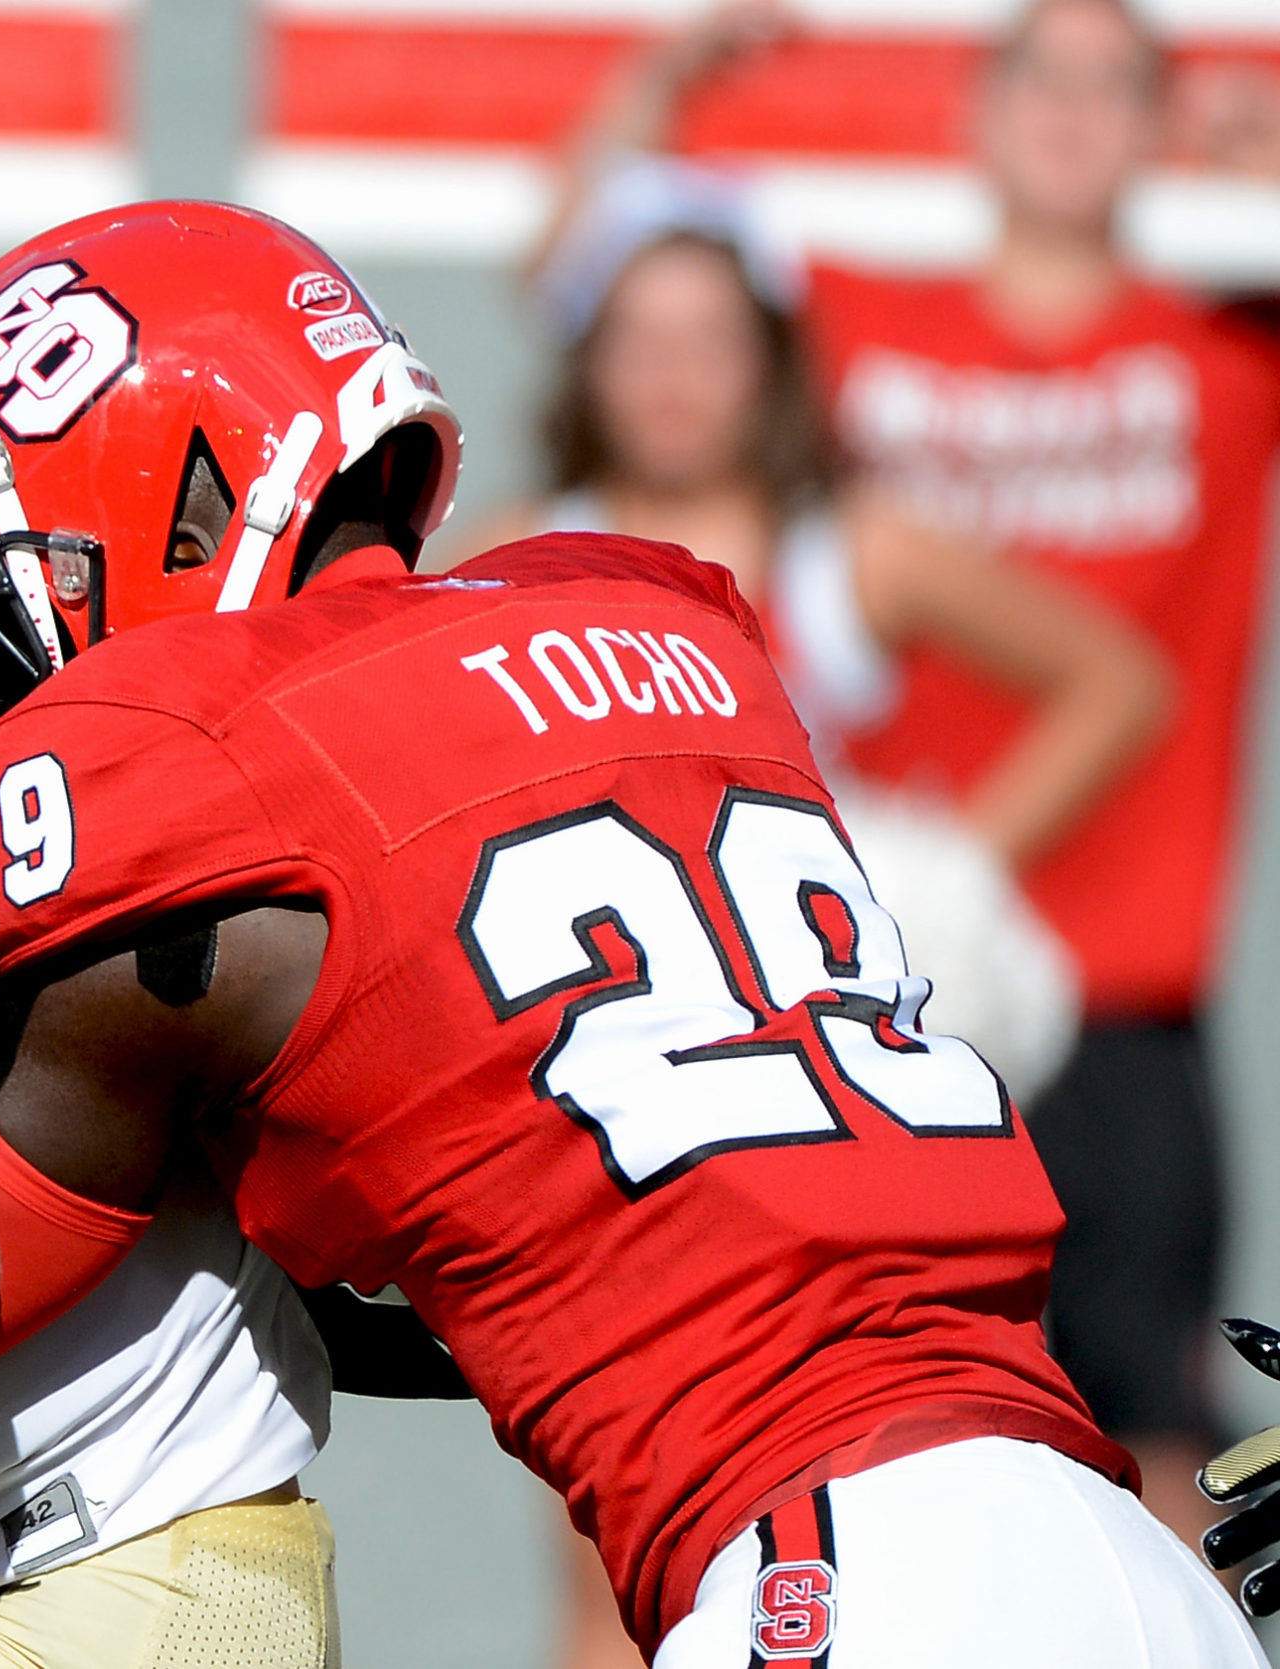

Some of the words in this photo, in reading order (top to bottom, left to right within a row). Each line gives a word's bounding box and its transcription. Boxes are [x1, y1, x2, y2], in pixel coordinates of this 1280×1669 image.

[301, 279, 342, 305] ACC
[461, 627, 738, 734] TOCHO
[455, 786, 1015, 1201] 29
[21, 1500, 56, 1530] 42
